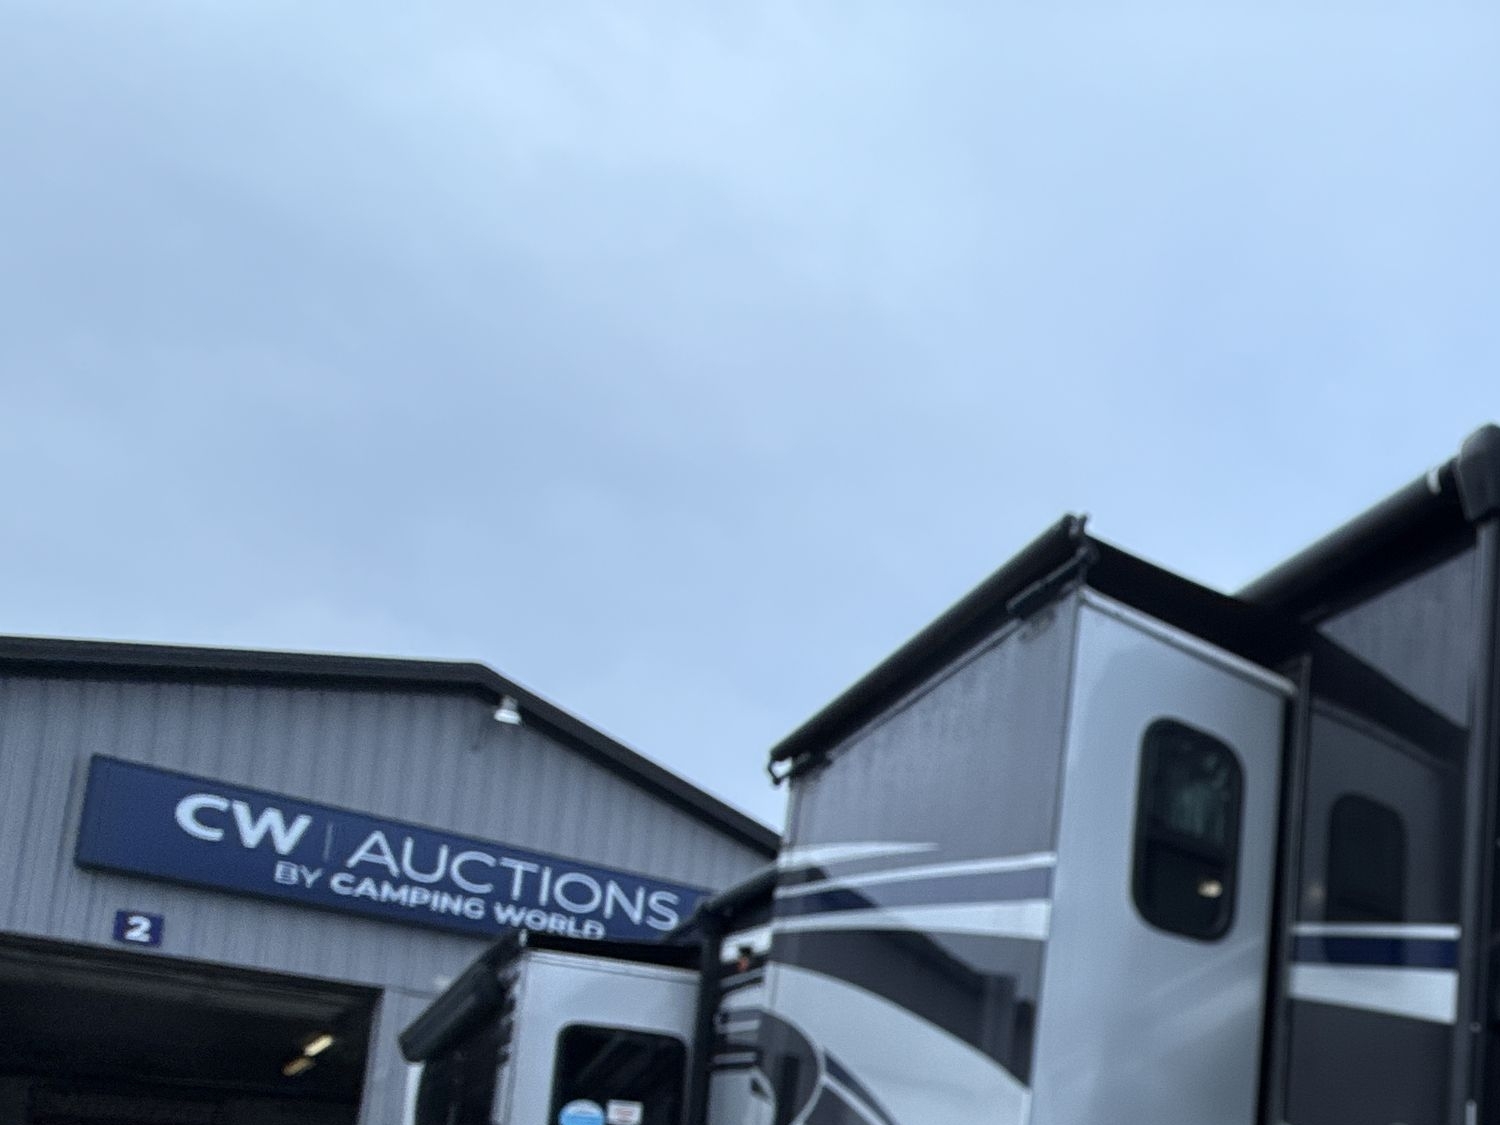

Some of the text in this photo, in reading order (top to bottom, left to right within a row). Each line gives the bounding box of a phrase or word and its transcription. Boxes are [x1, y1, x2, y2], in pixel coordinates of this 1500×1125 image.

[175, 793, 680, 931] CW AUCTIONS
[274, 860, 606, 939] BY CAMPING WORLD
[125, 916, 151, 942] 2
